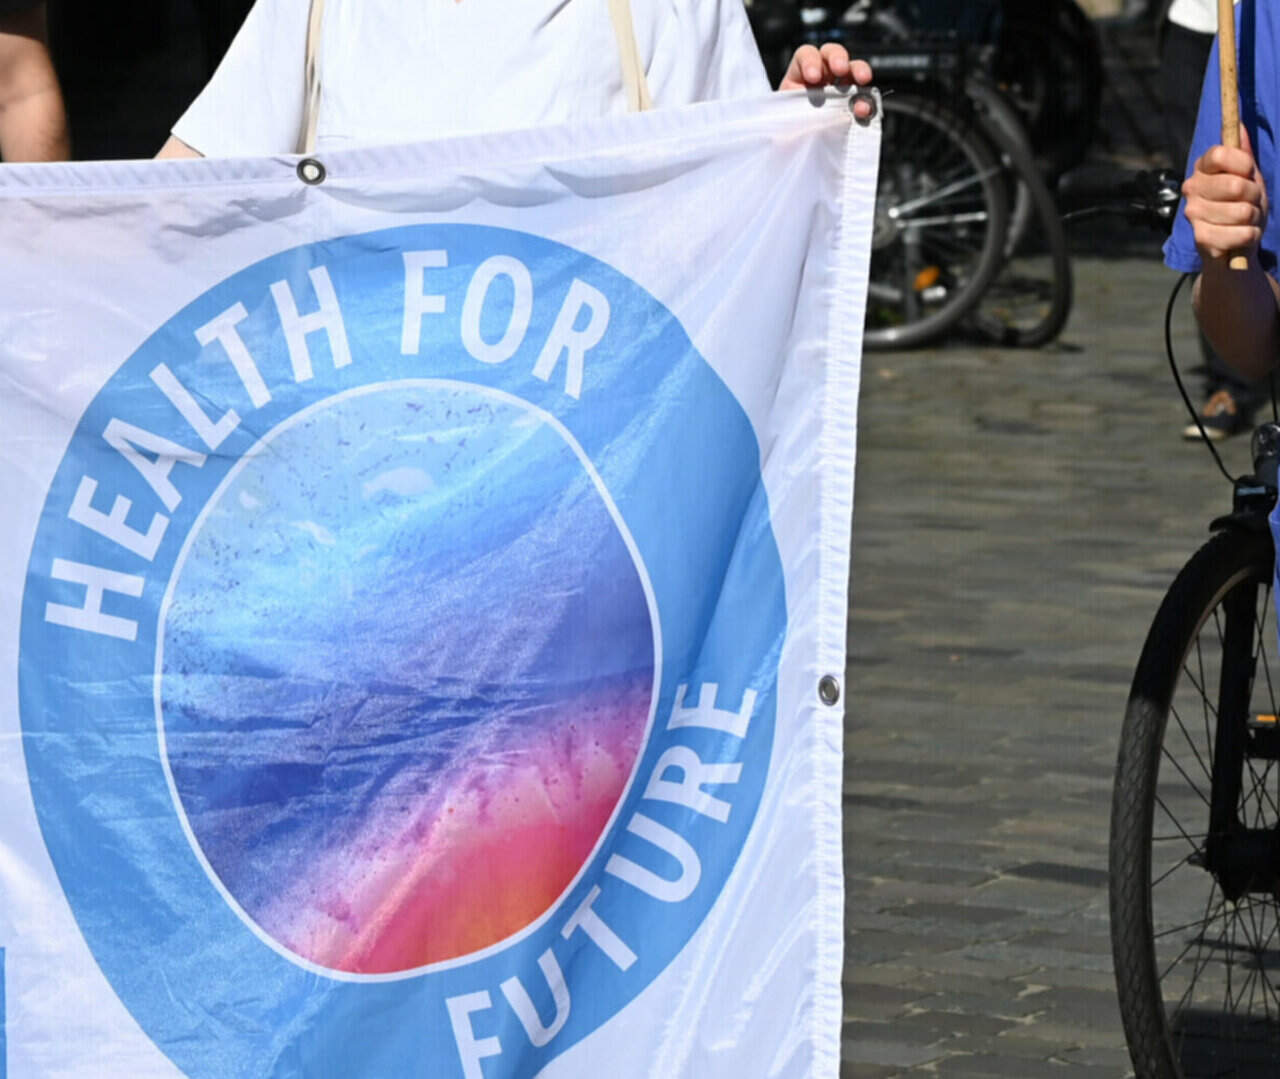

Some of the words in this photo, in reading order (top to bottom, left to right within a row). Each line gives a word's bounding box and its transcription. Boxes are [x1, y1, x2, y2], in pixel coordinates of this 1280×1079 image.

[45, 265, 352, 642] HEALTH
[400, 250, 612, 399] FOR
[445, 681, 758, 1079] FUTURE
